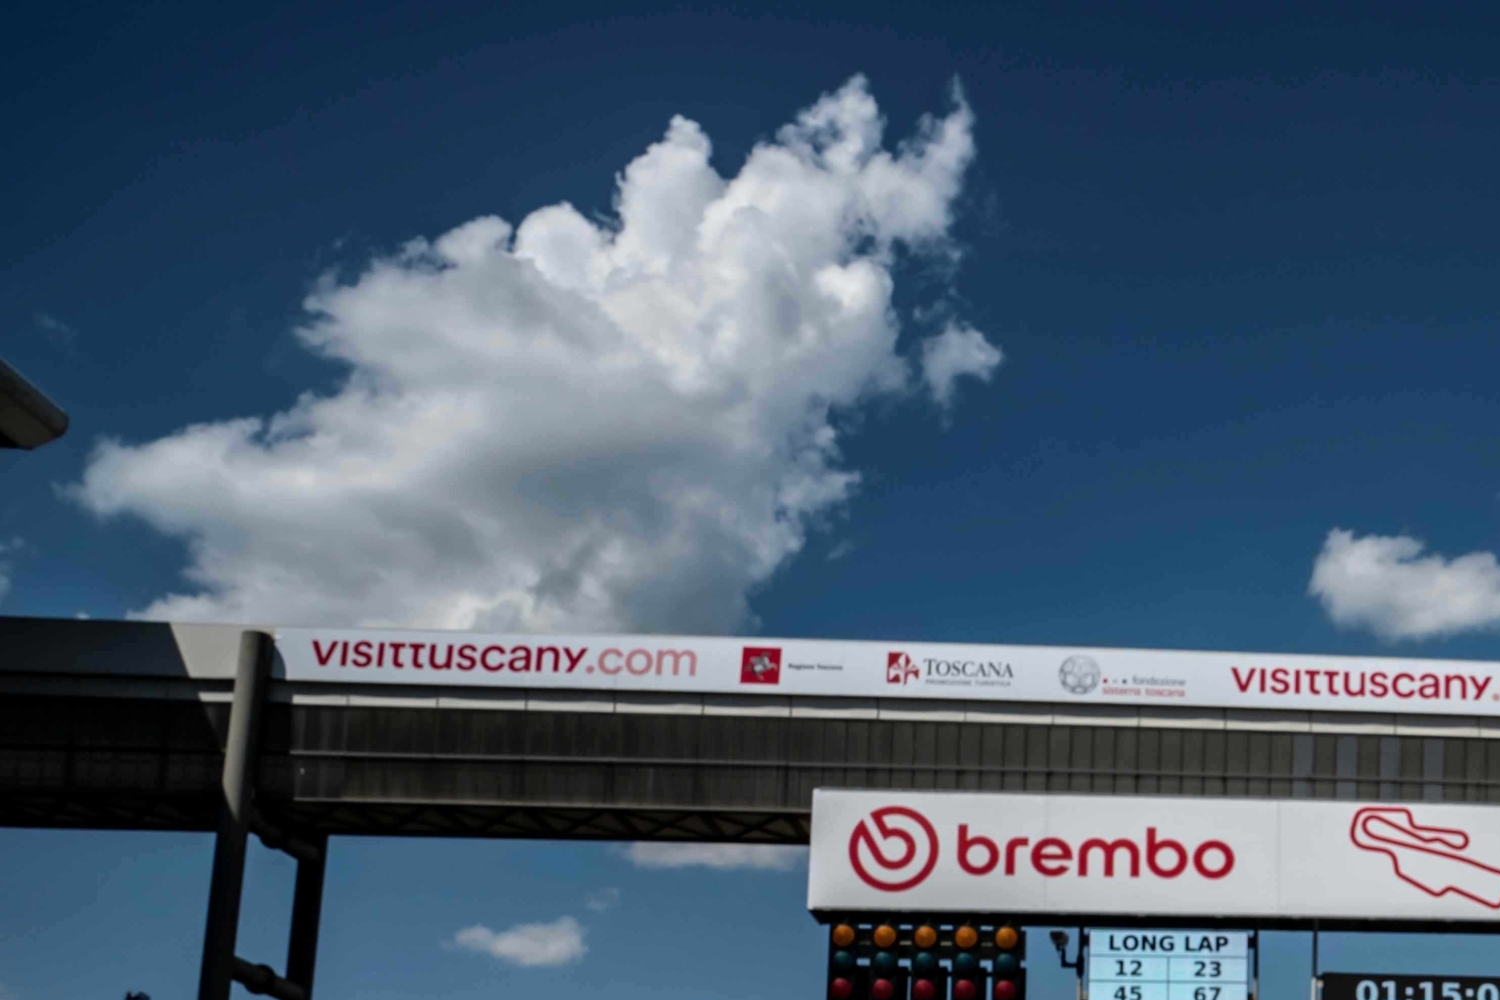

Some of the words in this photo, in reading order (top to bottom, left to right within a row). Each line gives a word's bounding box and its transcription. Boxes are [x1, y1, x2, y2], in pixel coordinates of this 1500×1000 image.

[923, 658, 1014, 679] TOSCANA
[957, 823, 1236, 880] brembo
[1109, 934, 1175, 953] LONG
[1184, 935, 1230, 953] LAP
[1114, 960, 1142, 977] 12
[1193, 961, 1222, 978] 23
